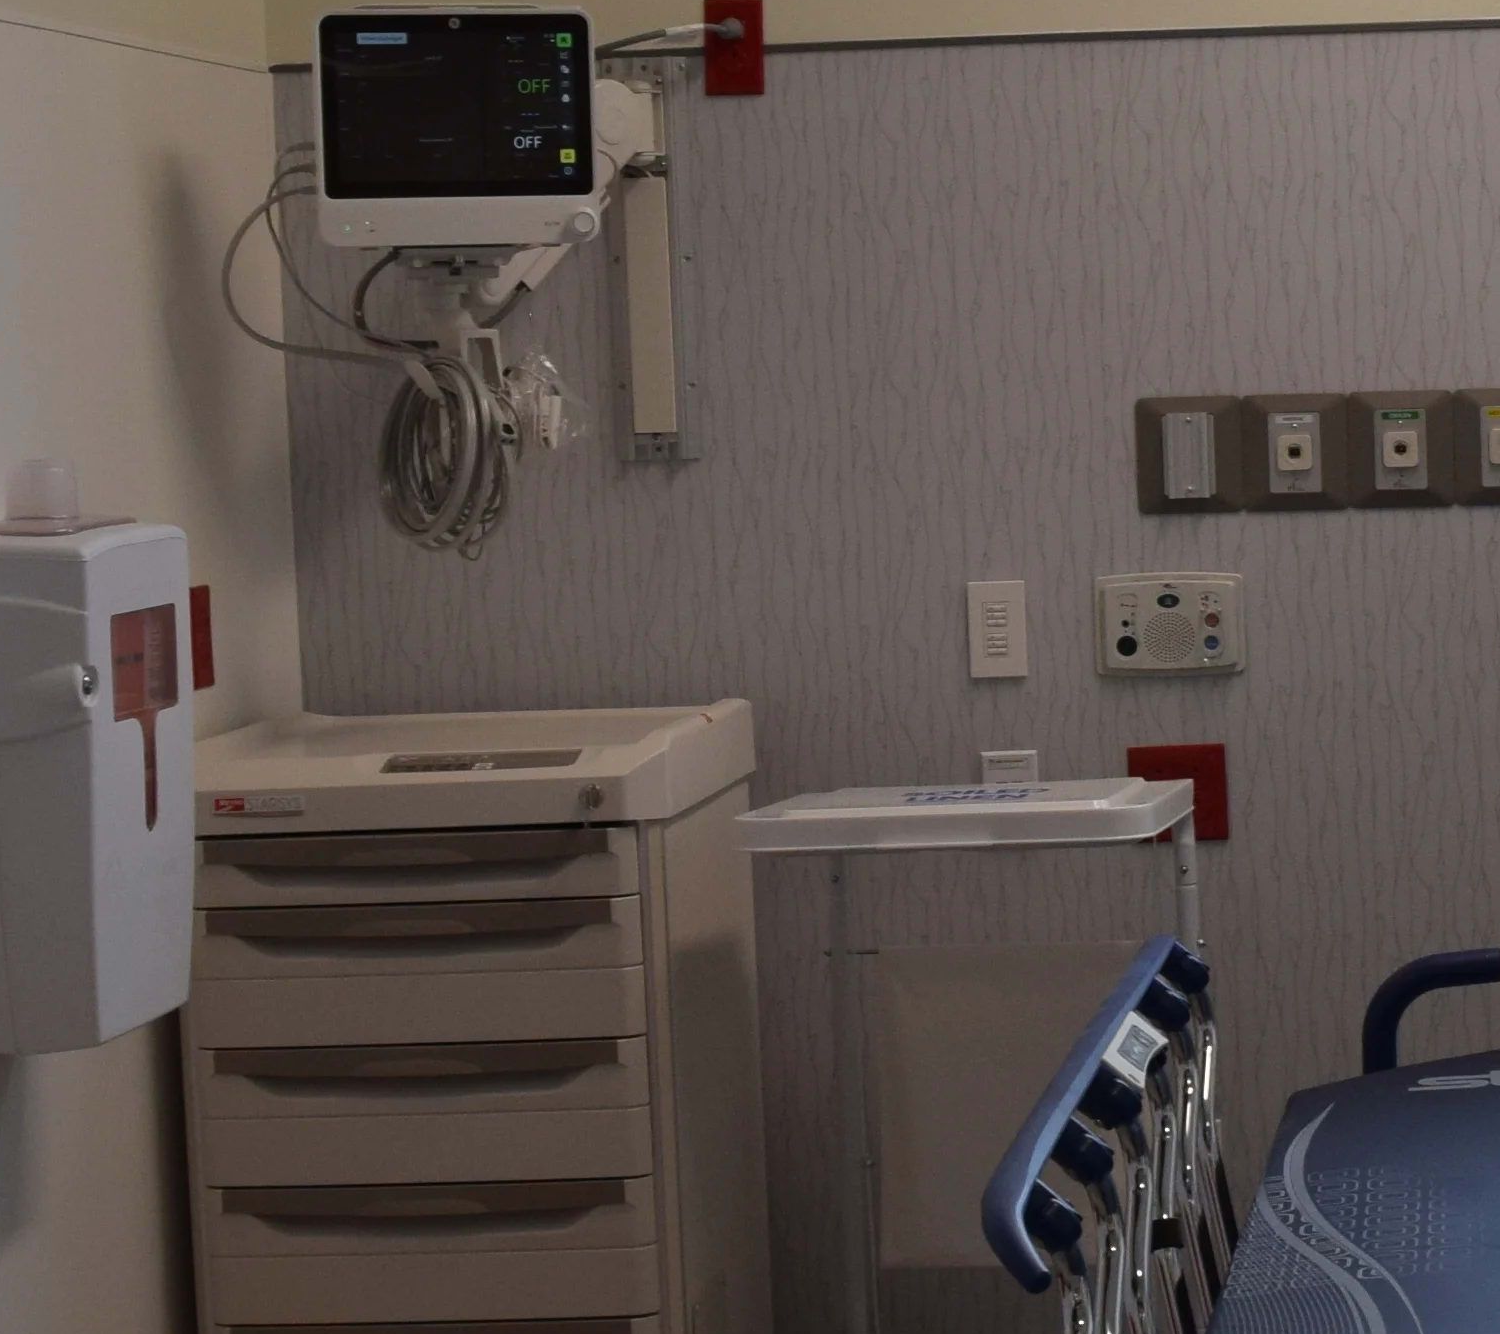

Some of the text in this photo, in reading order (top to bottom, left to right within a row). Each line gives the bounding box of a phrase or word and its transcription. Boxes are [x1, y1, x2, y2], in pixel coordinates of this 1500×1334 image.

[517, 78, 551, 94] OFF
[513, 136, 543, 149] OFF
[902, 788, 1050, 797] SOILED
[905, 793, 1028, 804] LINEN
